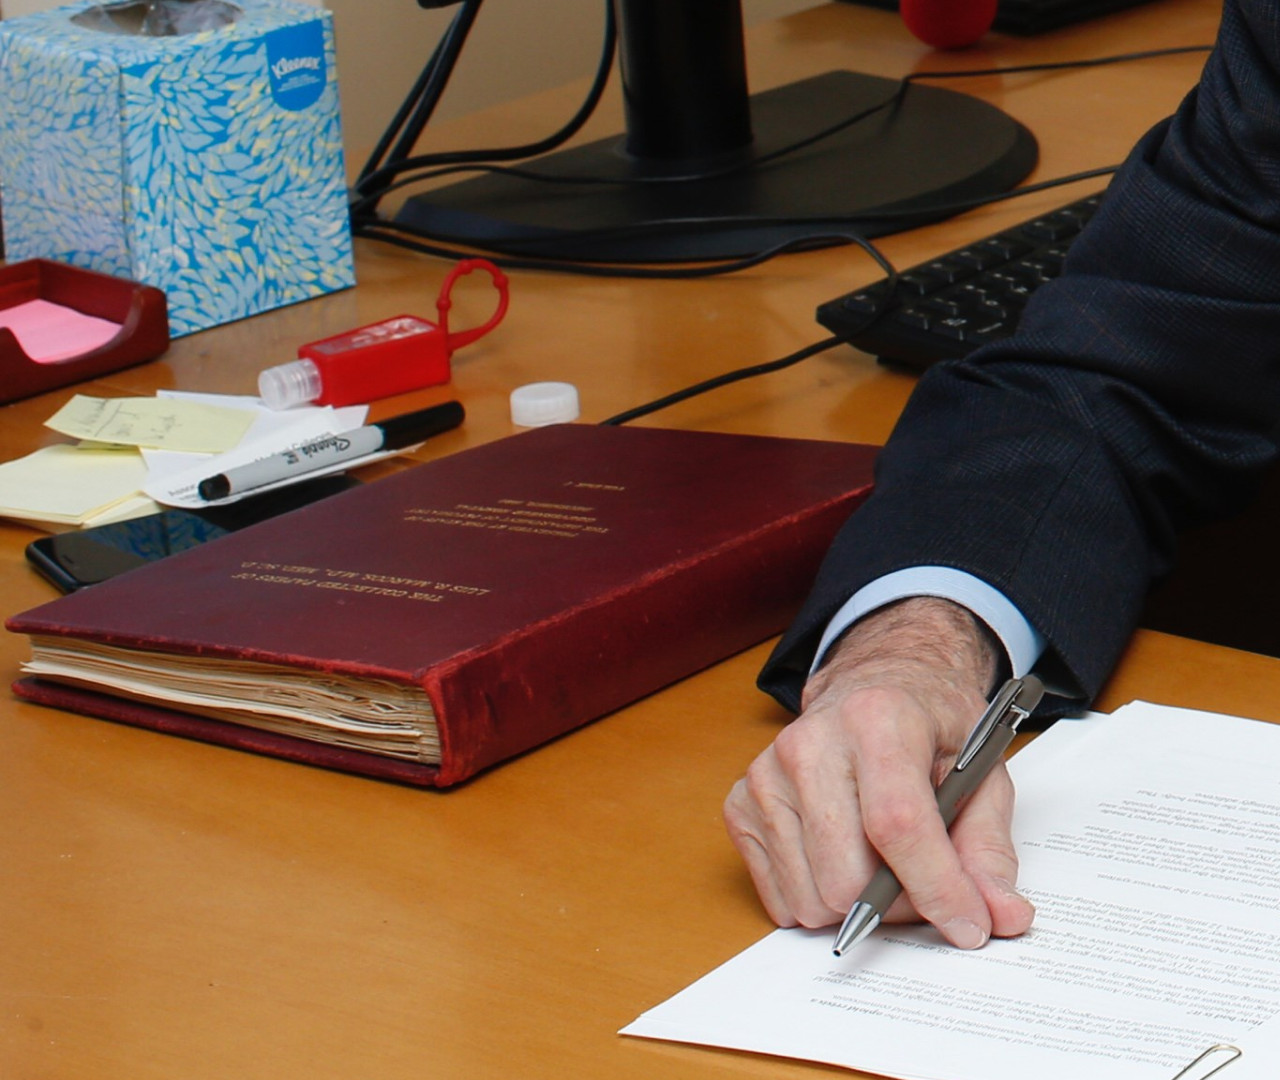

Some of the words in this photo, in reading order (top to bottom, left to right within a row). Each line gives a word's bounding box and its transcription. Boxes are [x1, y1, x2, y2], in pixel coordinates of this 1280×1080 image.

[271, 56, 321, 80] Kleenex
[301, 436, 351, 458] Sharpie
[256, 575, 316, 585] PAPERS
[316, 582, 407, 596] COLLECTED
[408, 592, 443, 601] THE
